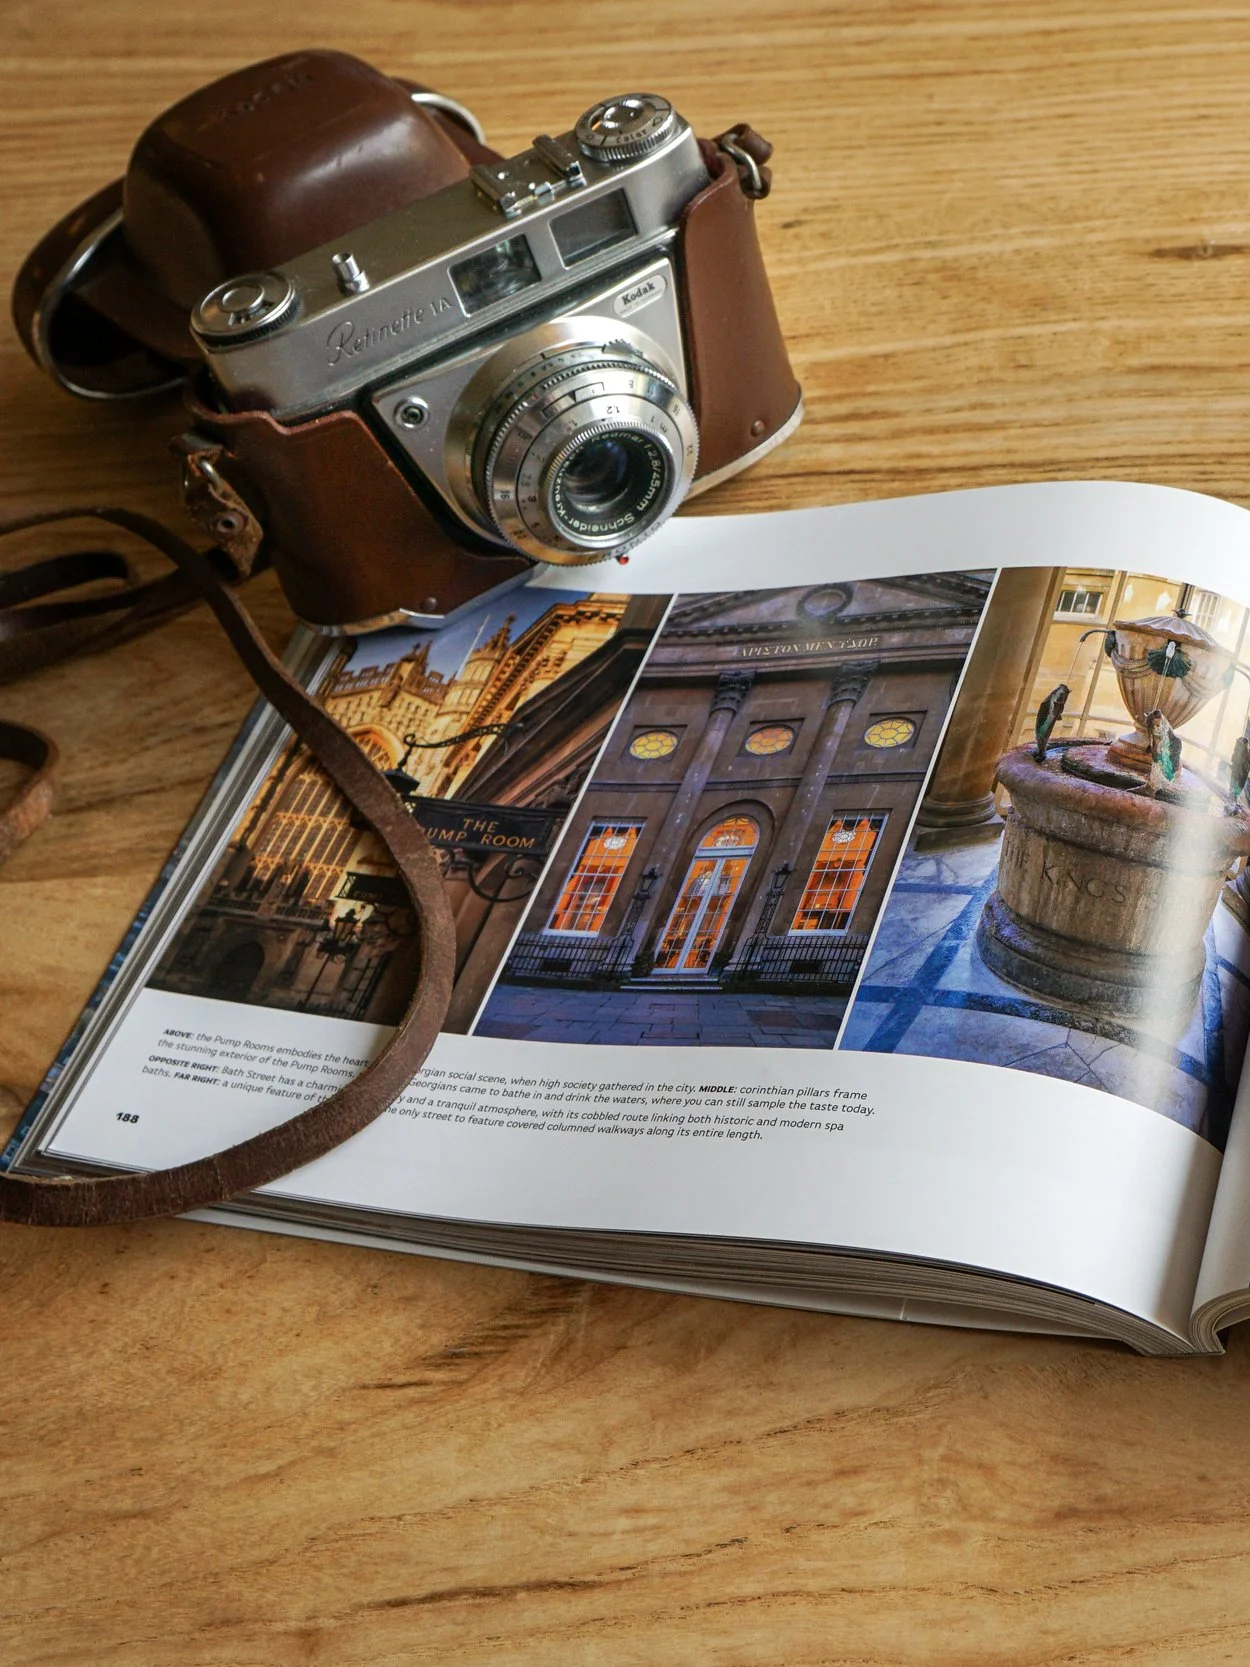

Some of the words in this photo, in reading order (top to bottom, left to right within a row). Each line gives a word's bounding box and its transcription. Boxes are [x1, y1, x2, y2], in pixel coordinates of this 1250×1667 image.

[622, 282, 656, 305] Kodak
[326, 307, 425, 367] Retinette
[463, 818, 500, 833] THE
[480, 833, 536, 849] ROOM
[149, 1055, 191, 1068] OPPOSITE
[191, 1063, 219, 1072] RIGHT:
[221, 1066, 245, 1077] Bath
[246, 1070, 277, 1083] Street
[278, 1075, 296, 1086] has
[407, 1097, 427, 1105] and
[437, 1100, 477, 1112] tranquil
[477, 1105, 539, 1119] atmosphere,
[542, 1109, 564, 1119] with
[566, 1110, 580, 1119] its
[581, 1112, 621, 1121] cobbled
[622, 1114, 649, 1122] route
[651, 1113, 686, 1126] linking
[687, 1114, 712, 1124] both
[714, 1115, 755, 1126] historic
[756, 1118, 778, 1127] and
[779, 1119, 822, 1129] modern
[825, 1123, 844, 1132] spa
[158, 1040, 174, 1049] the
[176, 1043, 218, 1058] stunning
[219, 1050, 258, 1062] exterior
[272, 1058, 289, 1068] the
[290, 1060, 319, 1074] Pump
[321, 1065, 355, 1078] Rooms.
[460, 1086, 487, 1095] came
[489, 1088, 500, 1096] to
[502, 1088, 531, 1099] bathe
[533, 1091, 543, 1100] in
[544, 1092, 565, 1101] and
[565, 1093, 592, 1102] drink
[594, 1094, 611, 1104] the
[613, 1096, 648, 1106] waters,
[652, 1096, 683, 1105] where
[683, 1099, 703, 1108] you
[726, 1098, 747, 1107] still
[748, 1099, 786, 1111] sample
[789, 1100, 807, 1110] the
[810, 1102, 839, 1112] taste
[842, 1104, 875, 1117] today.
[164, 1029, 194, 1039] ABOVE:
[196, 1033, 213, 1042] the
[214, 1035, 242, 1048] Pump
[243, 1040, 275, 1053] Rooms
[276, 1048, 323, 1061] embodies
[325, 1054, 341, 1063] the
[343, 1057, 369, 1068] heart
[448, 1072, 477, 1081] social
[478, 1076, 508, 1086] scene,
[511, 1078, 537, 1086] when
[539, 1079, 561, 1090] high
[563, 1082, 598, 1092] society
[598, 1082, 645, 1093] gathered
[645, 1083, 655, 1092] in
[657, 1083, 674, 1092] the
[676, 1084, 696, 1095] city.
[699, 1086, 738, 1094] MIDDLE:
[740, 1085, 795, 1096] corinthian
[796, 1087, 831, 1098] pillars
[834, 1089, 868, 1100] frame
[115, 1112, 140, 1124] 188
[142, 1065, 171, 1077] baths.
[174, 1072, 191, 1081] FAR
[192, 1075, 221, 1085] RIGHT:
[231, 1082, 264, 1093] unique
[266, 1086, 302, 1099] feature
[304, 1093, 317, 1101] of
[399, 1108, 421, 1119] only
[422, 1112, 453, 1121] street
[455, 1115, 466, 1123] to
[468, 1115, 505, 1127] feature
[507, 1121, 547, 1130] covered
[547, 1123, 597, 1133] columned
[598, 1125, 645, 1137] walkways
[647, 1126, 675, 1139] along
[677, 1127, 691, 1137] its
[693, 1130, 725, 1138] entire
[726, 1130, 763, 1142] length.
